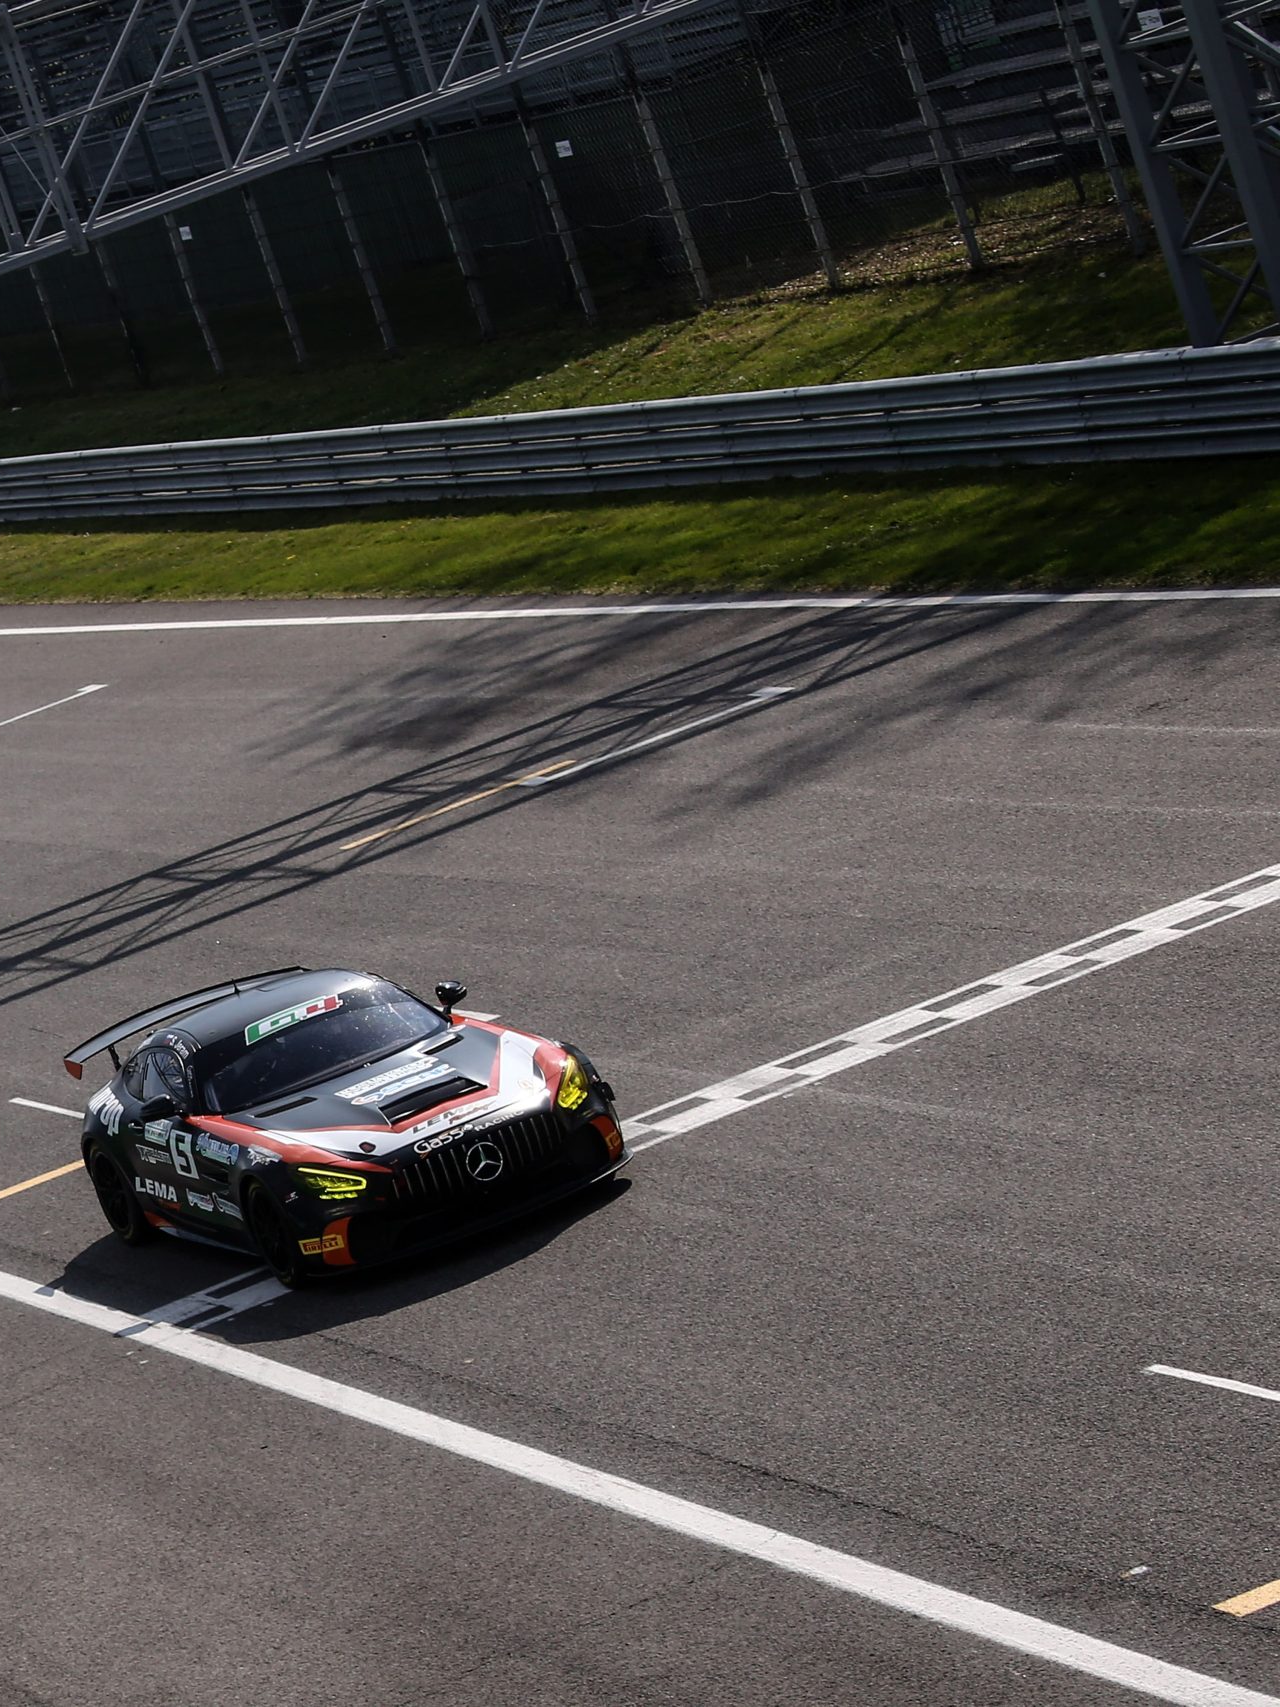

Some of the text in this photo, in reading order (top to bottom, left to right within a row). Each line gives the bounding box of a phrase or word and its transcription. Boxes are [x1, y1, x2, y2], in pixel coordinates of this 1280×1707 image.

[412, 1102, 473, 1134] LEM
[474, 1110, 525, 1132] RACING
[135, 1177, 178, 1202] LEMA
